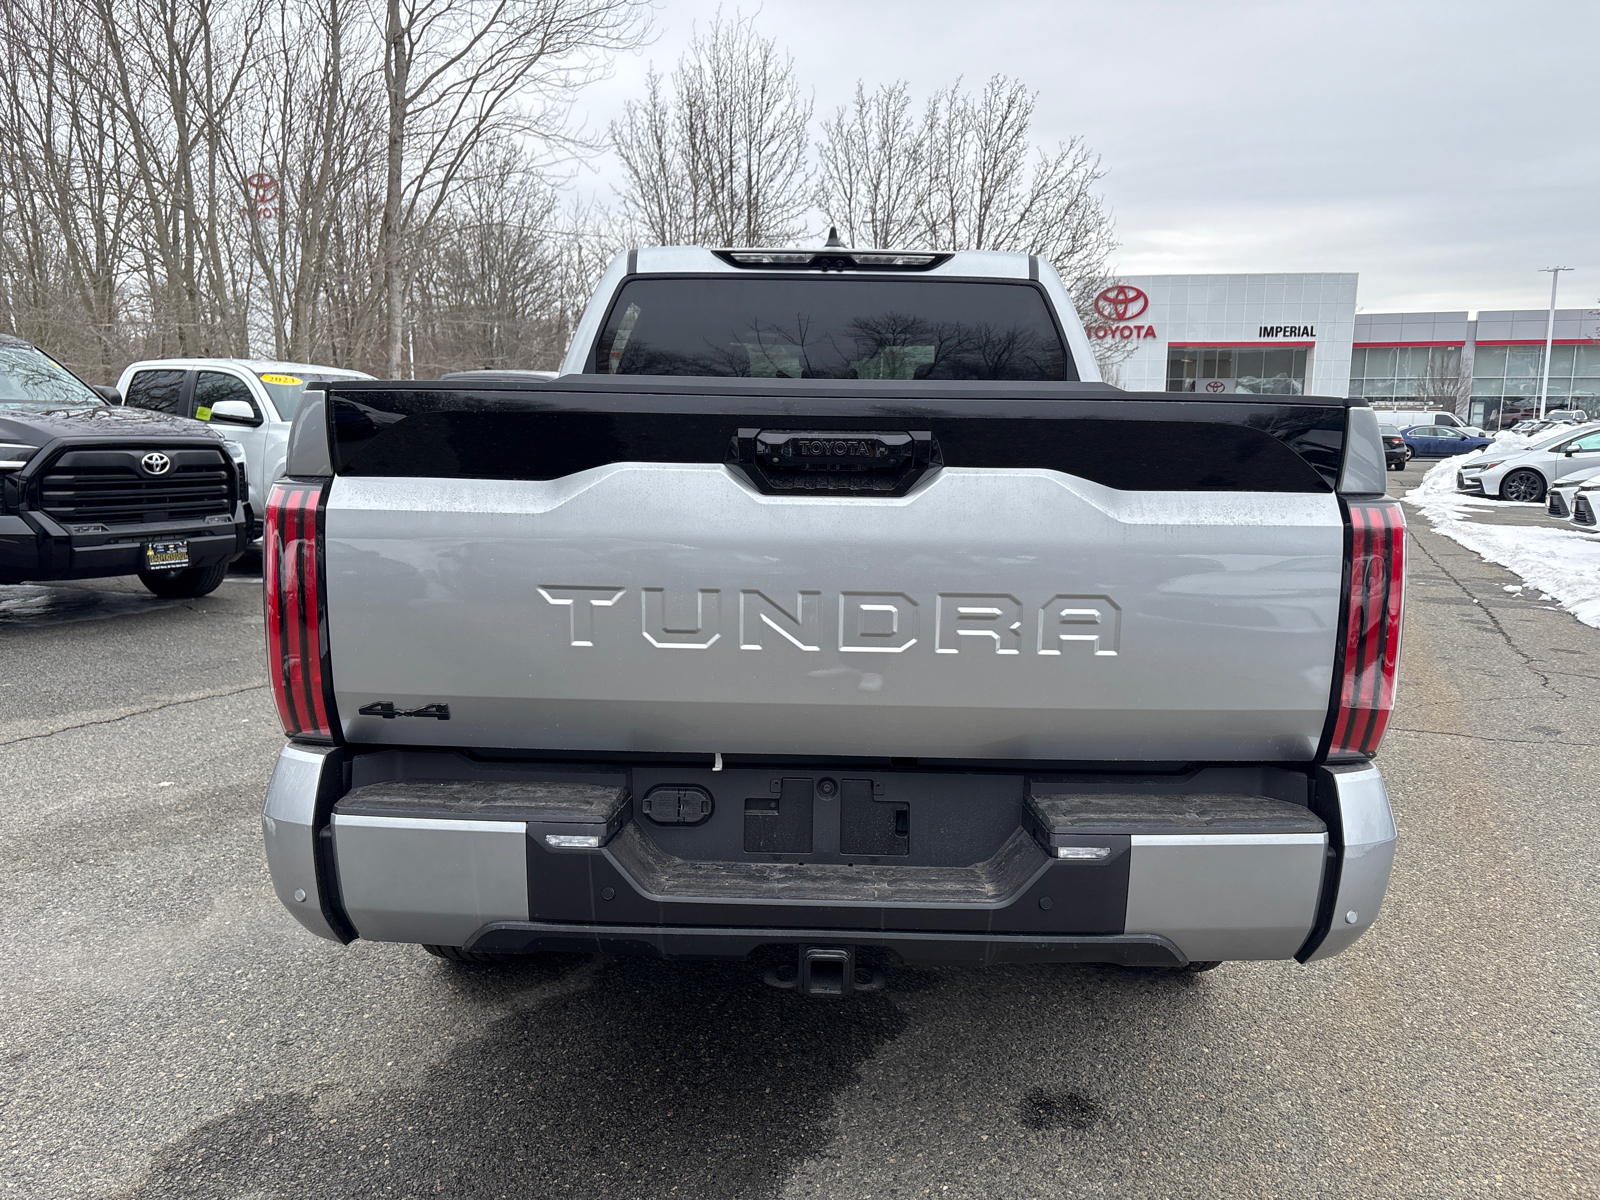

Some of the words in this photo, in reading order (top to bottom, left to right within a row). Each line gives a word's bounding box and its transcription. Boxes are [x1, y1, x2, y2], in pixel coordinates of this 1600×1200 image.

[1259, 325, 1316, 338] IMPERIAL
[798, 440, 870, 456] TOYOTA
[536, 584, 1122, 657] TUNDRA
